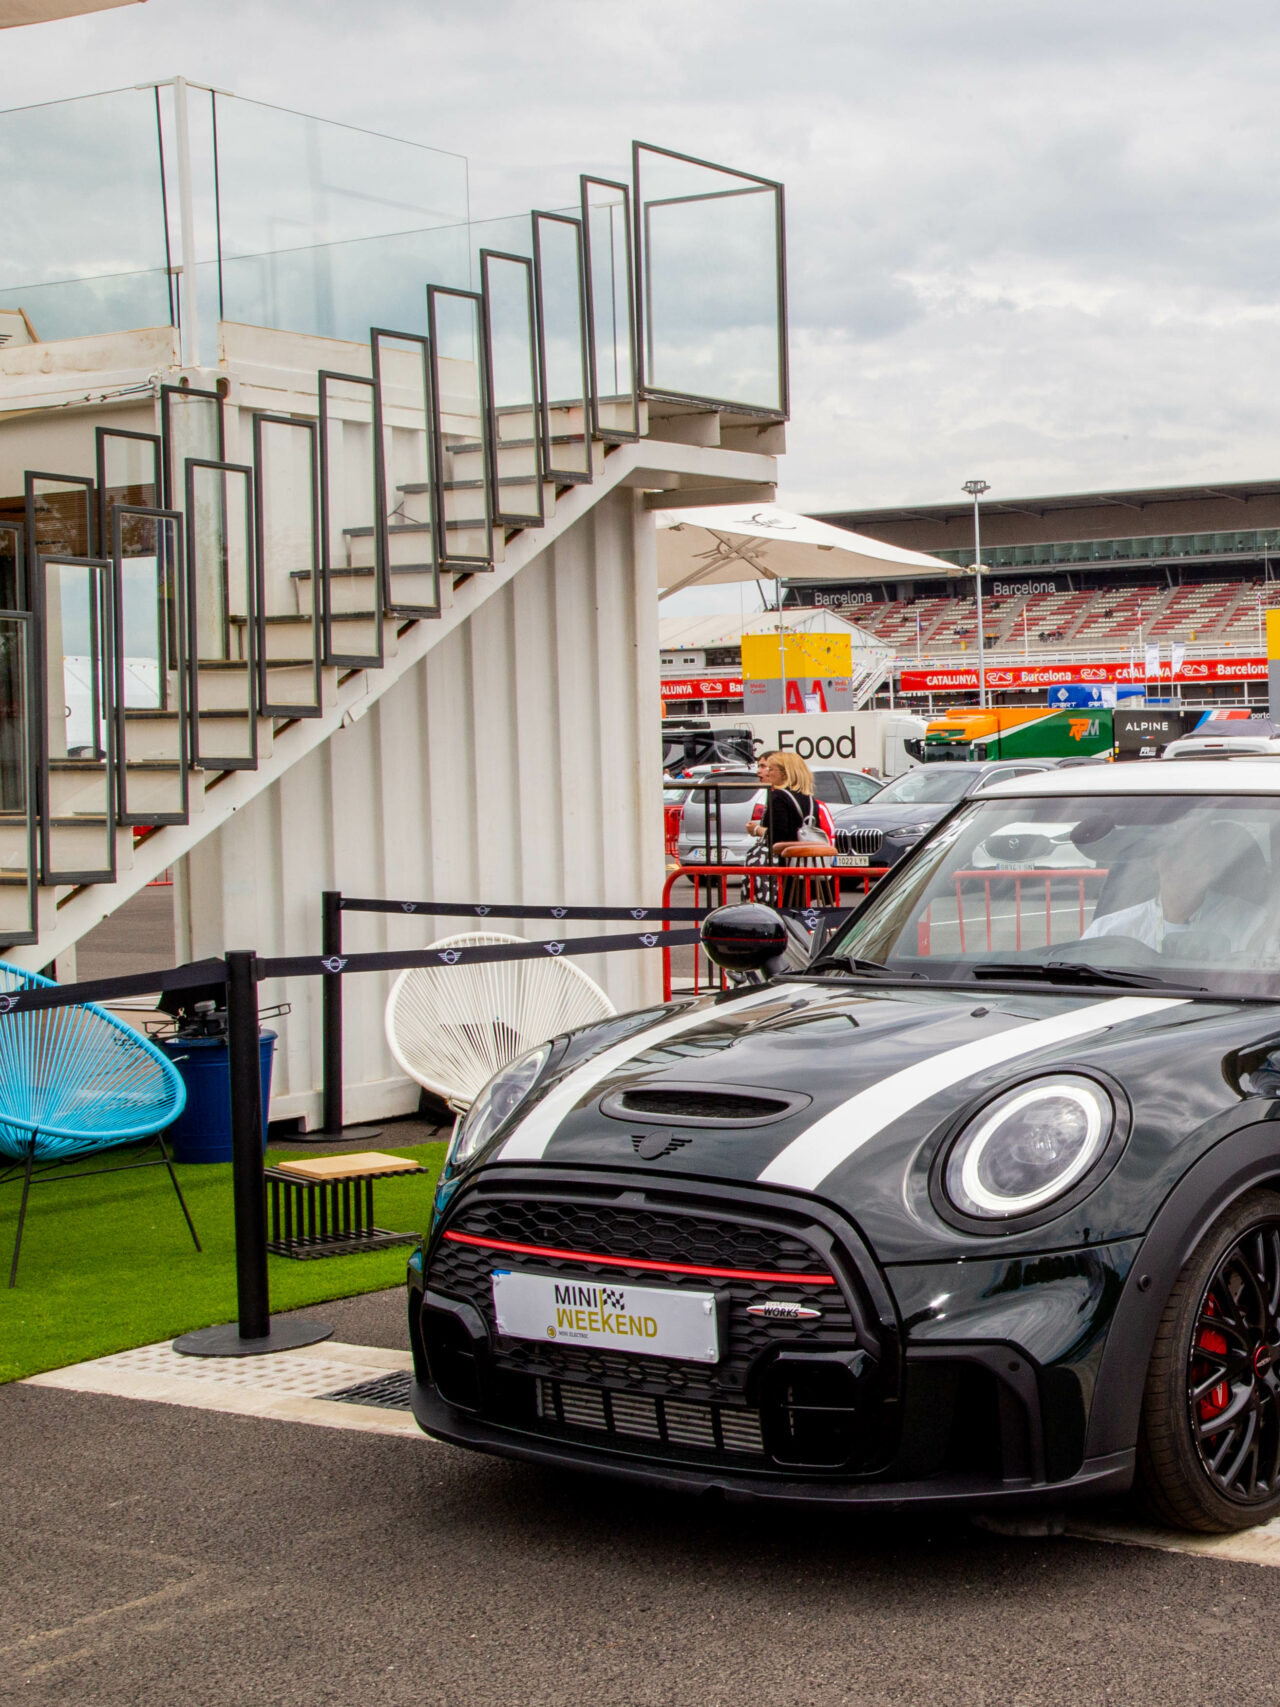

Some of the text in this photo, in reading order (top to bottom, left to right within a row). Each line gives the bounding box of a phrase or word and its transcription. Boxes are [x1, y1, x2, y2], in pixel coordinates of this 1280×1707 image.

[993, 580, 1056, 596] Barcelona
[814, 591, 873, 605] Barcelona
[926, 673, 977, 686] CATALUNYA
[1021, 669, 1072, 683] Barcelona
[1125, 722, 1168, 731] ALPINE
[778, 726, 857, 760] Food
[554, 1284, 597, 1308] MINI
[556, 1290, 658, 1338] WEEKEND
[764, 1307, 799, 1318] WORKS
